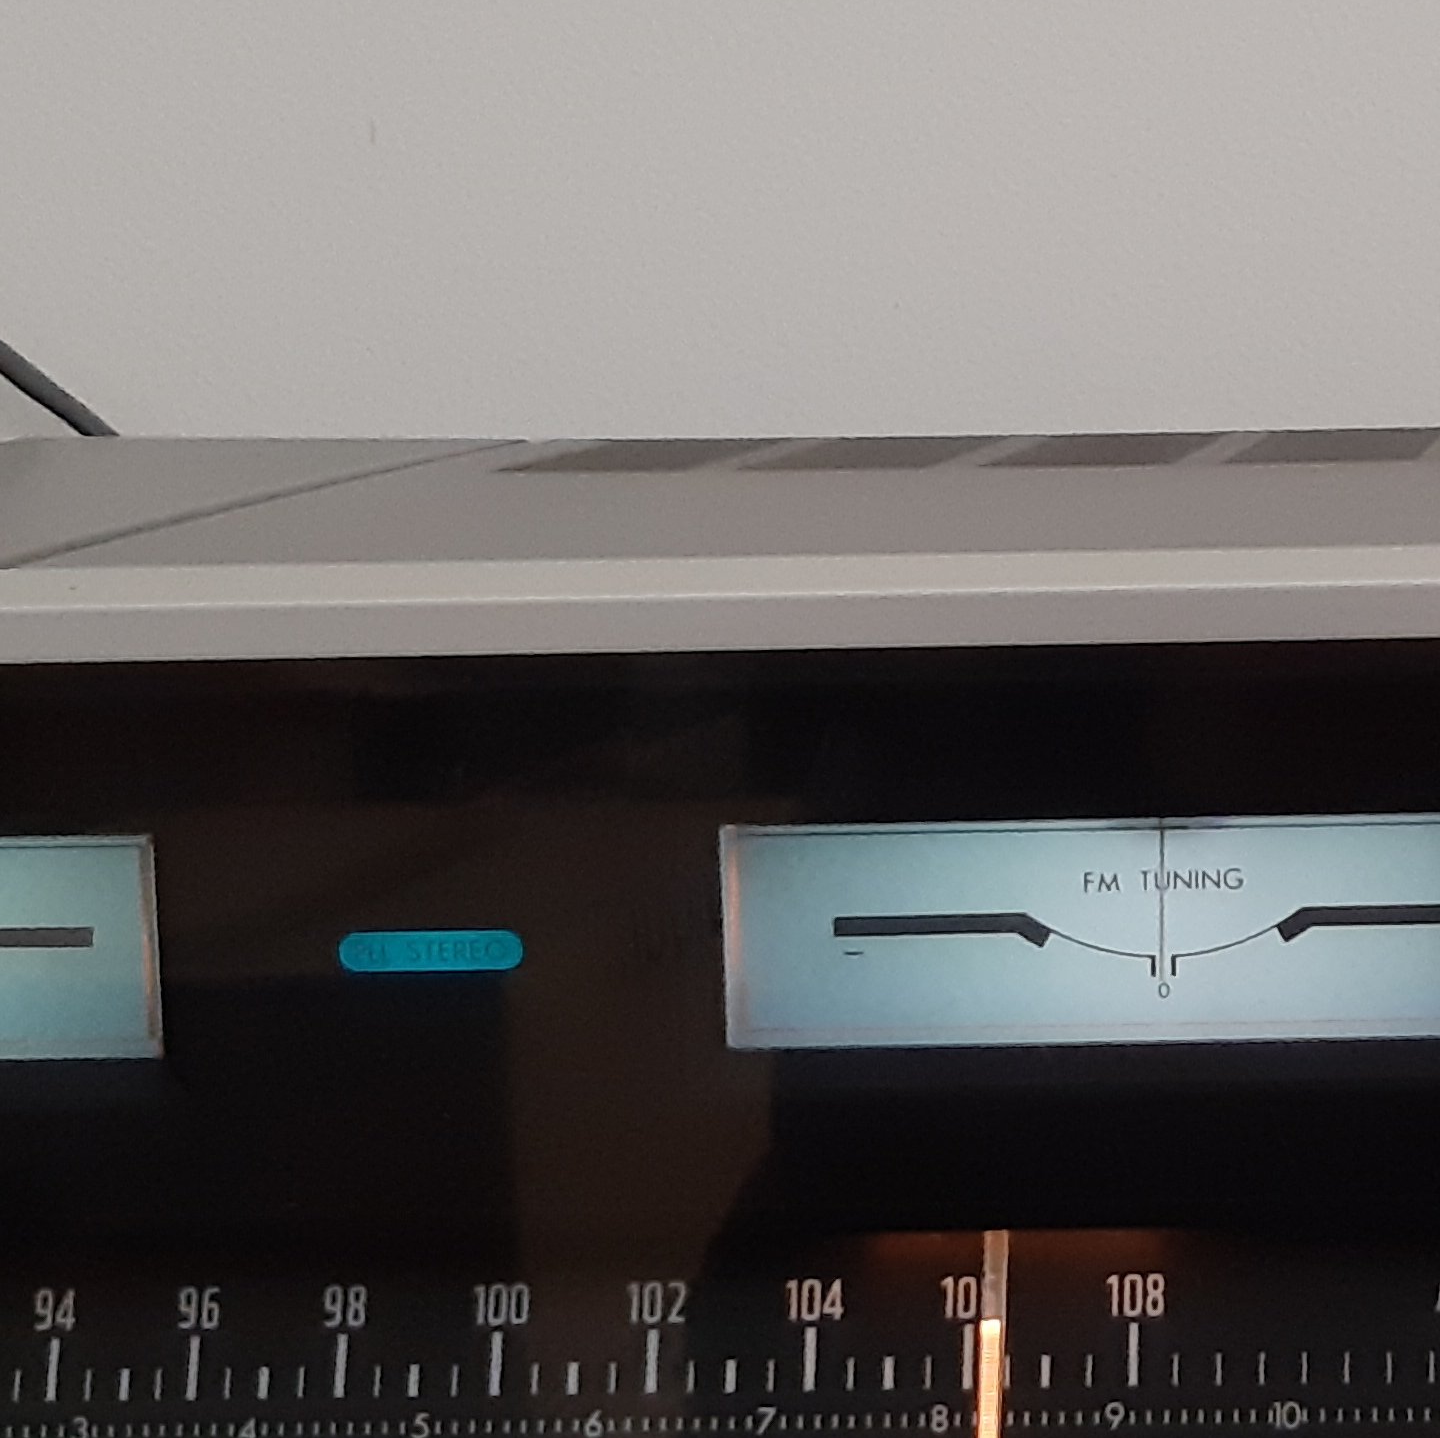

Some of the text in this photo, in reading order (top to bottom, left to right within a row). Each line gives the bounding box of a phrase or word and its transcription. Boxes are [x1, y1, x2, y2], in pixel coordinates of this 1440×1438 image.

[1083, 868, 1244, 894] FM TUNING
[34, 1288, 76, 1332] 94
[177, 1286, 220, 1330] 96
[323, 1285, 367, 1328] 98
[474, 1283, 530, 1327] 100
[628, 1281, 687, 1325] 102
[786, 1278, 844, 1322] 104
[940, 1274, 1000, 1320] 10
[1106, 1273, 1165, 1318] 108
[583, 1410, 603, 1438] 6
[756, 1406, 777, 1436] 7
[930, 1404, 949, 1434] 8
[1104, 1401, 1125, 1431] 9
[1273, 1401, 1301, 1431] 10
